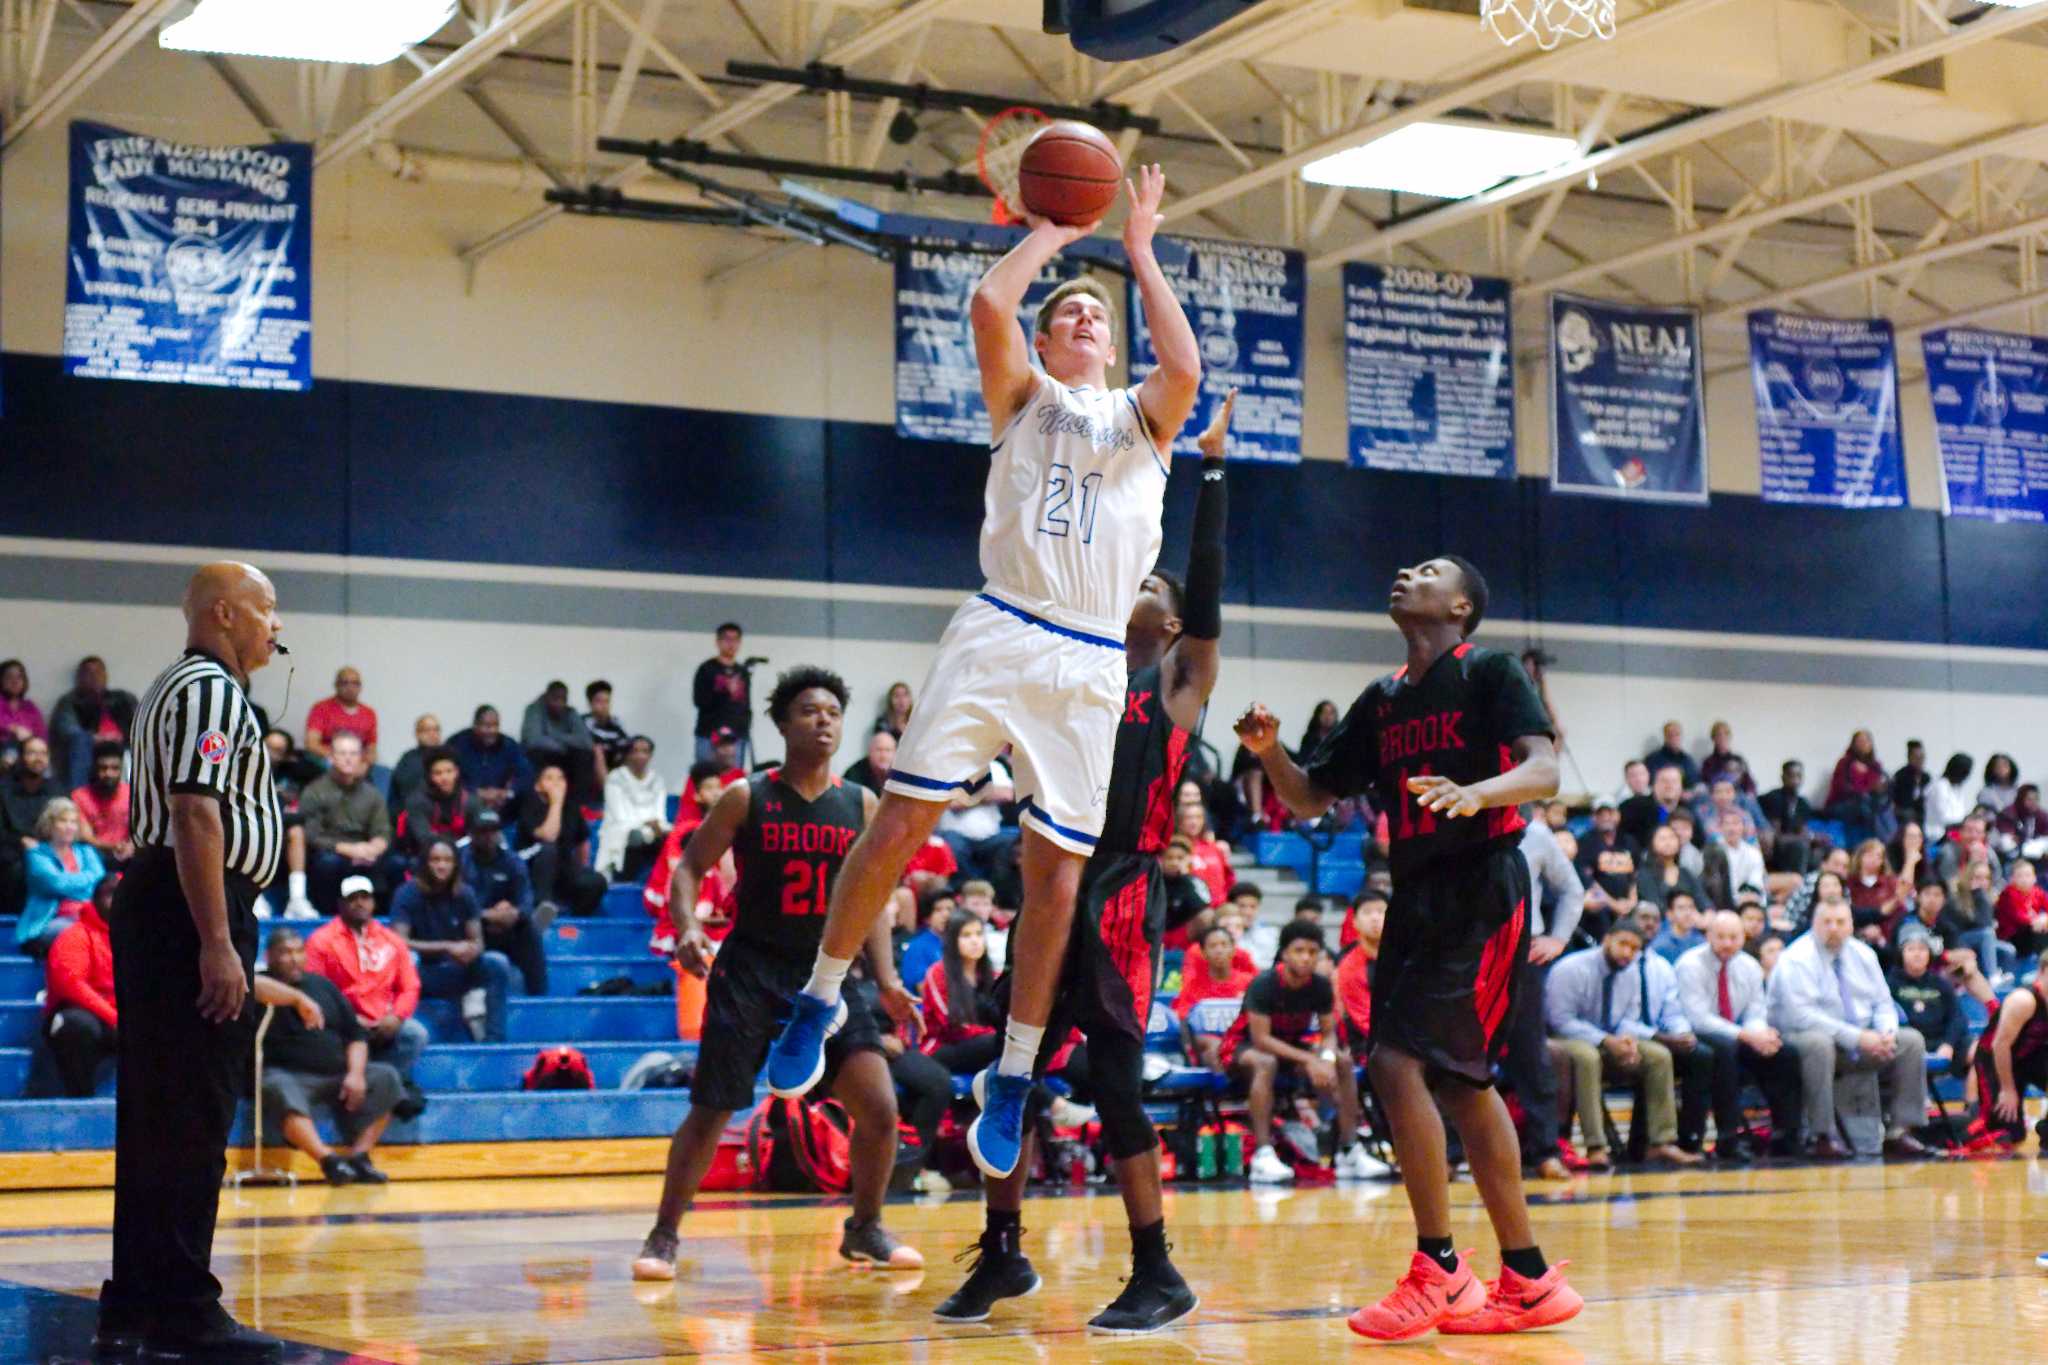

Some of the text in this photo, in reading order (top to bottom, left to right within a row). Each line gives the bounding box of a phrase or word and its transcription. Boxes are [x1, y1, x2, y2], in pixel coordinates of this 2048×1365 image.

[94, 136, 291, 178] FRIENDSWOOD
[167, 158, 291, 201] MUSTANGS
[1381, 266, 1474, 302] 2008-09
[1610, 321, 1692, 358] NEAL
[1037, 462, 1104, 545] 21
[1379, 711, 1467, 767] BROOK
[761, 822, 857, 857] BROOK
[782, 860, 829, 916] 21
